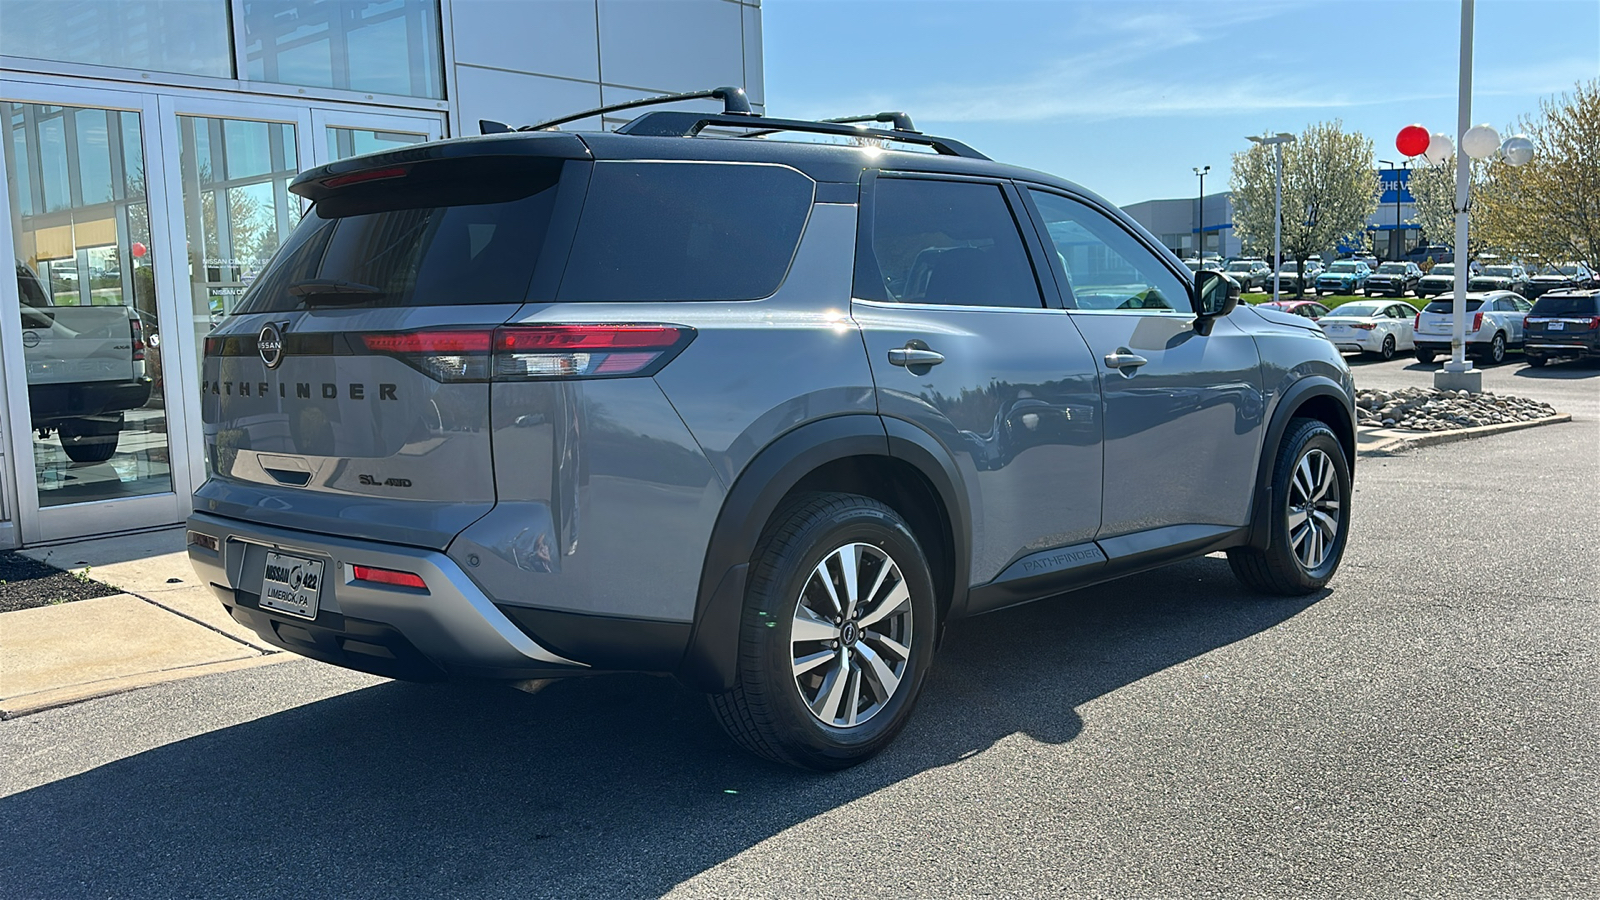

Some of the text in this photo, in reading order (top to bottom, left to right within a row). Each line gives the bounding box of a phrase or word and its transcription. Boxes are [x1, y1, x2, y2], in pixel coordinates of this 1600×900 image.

[203, 380, 398, 400] PATHFINDER
[359, 474, 382, 486] SL
[1022, 548, 1102, 571] PATHFINDER
[265, 565, 317, 590] NISSAN 422
[267, 587, 308, 606] LIMERICK, PA
